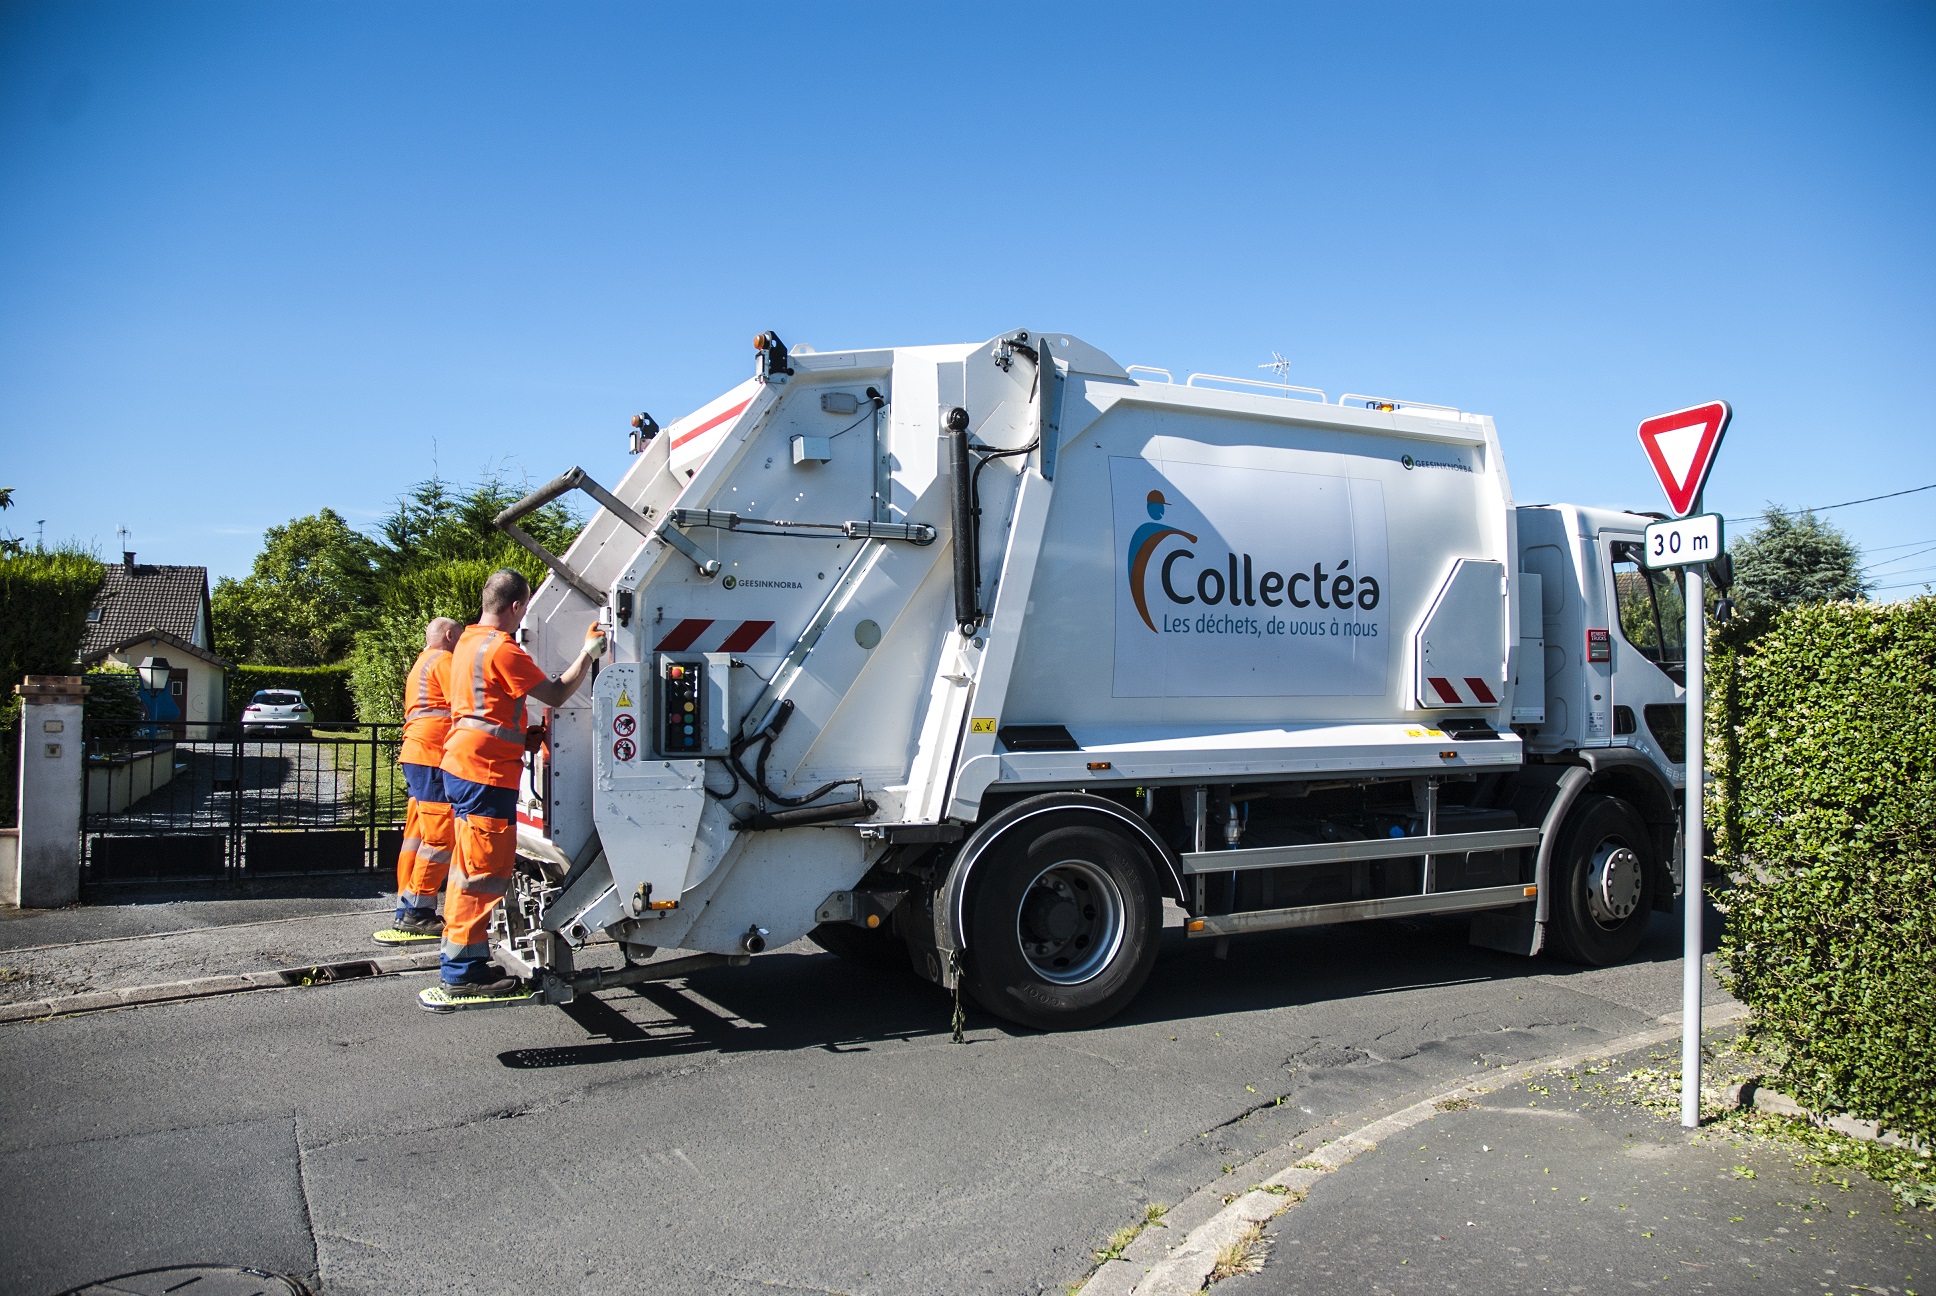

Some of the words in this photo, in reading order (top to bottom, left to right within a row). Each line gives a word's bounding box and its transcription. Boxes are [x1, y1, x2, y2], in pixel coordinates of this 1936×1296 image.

[1415, 460, 1474, 473] GEESINKNORBA
[1654, 531, 1681, 556] 30
[1693, 535, 1708, 551] m
[738, 579, 803, 589] GEESINKNORBA
[1161, 549, 1380, 611] Collectéa
[1163, 613, 1190, 633] Les
[1196, 613, 1262, 639] déchets,
[1266, 615, 1285, 635] de
[1290, 621, 1326, 636] vous
[1330, 617, 1339, 636] à
[1344, 622, 1378, 637] nous
